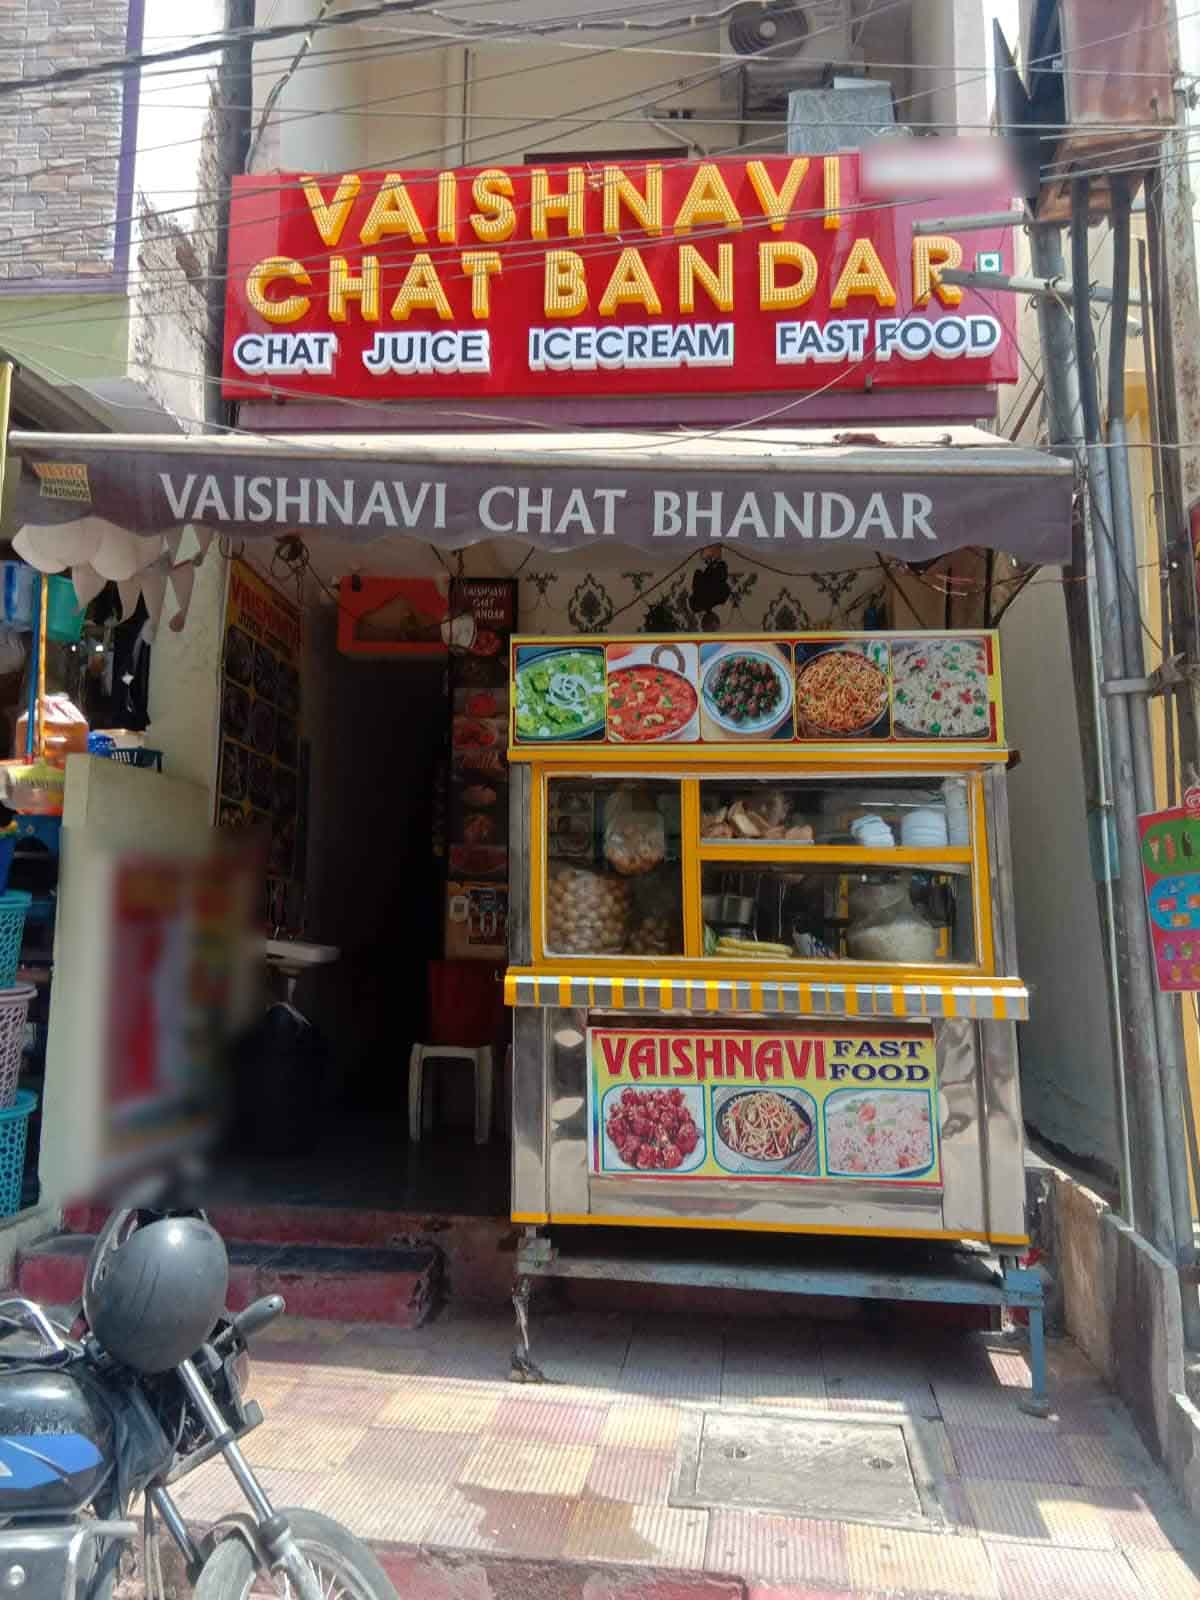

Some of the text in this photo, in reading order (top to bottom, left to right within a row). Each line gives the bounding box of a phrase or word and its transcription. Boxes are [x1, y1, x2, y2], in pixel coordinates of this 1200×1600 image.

[300, 156, 841, 247] VAISHNAVI
[245, 235, 963, 323] CHAT BANDAR
[234, 315, 1001, 374] CHAT JUICE ICECREAM FAST FOOD
[160, 473, 937, 539] VAISHNAVI CHAT BHANDAR
[601, 1038, 922, 1080] VAISHNAVI FAST
[829, 1063, 930, 1081] FOOD
